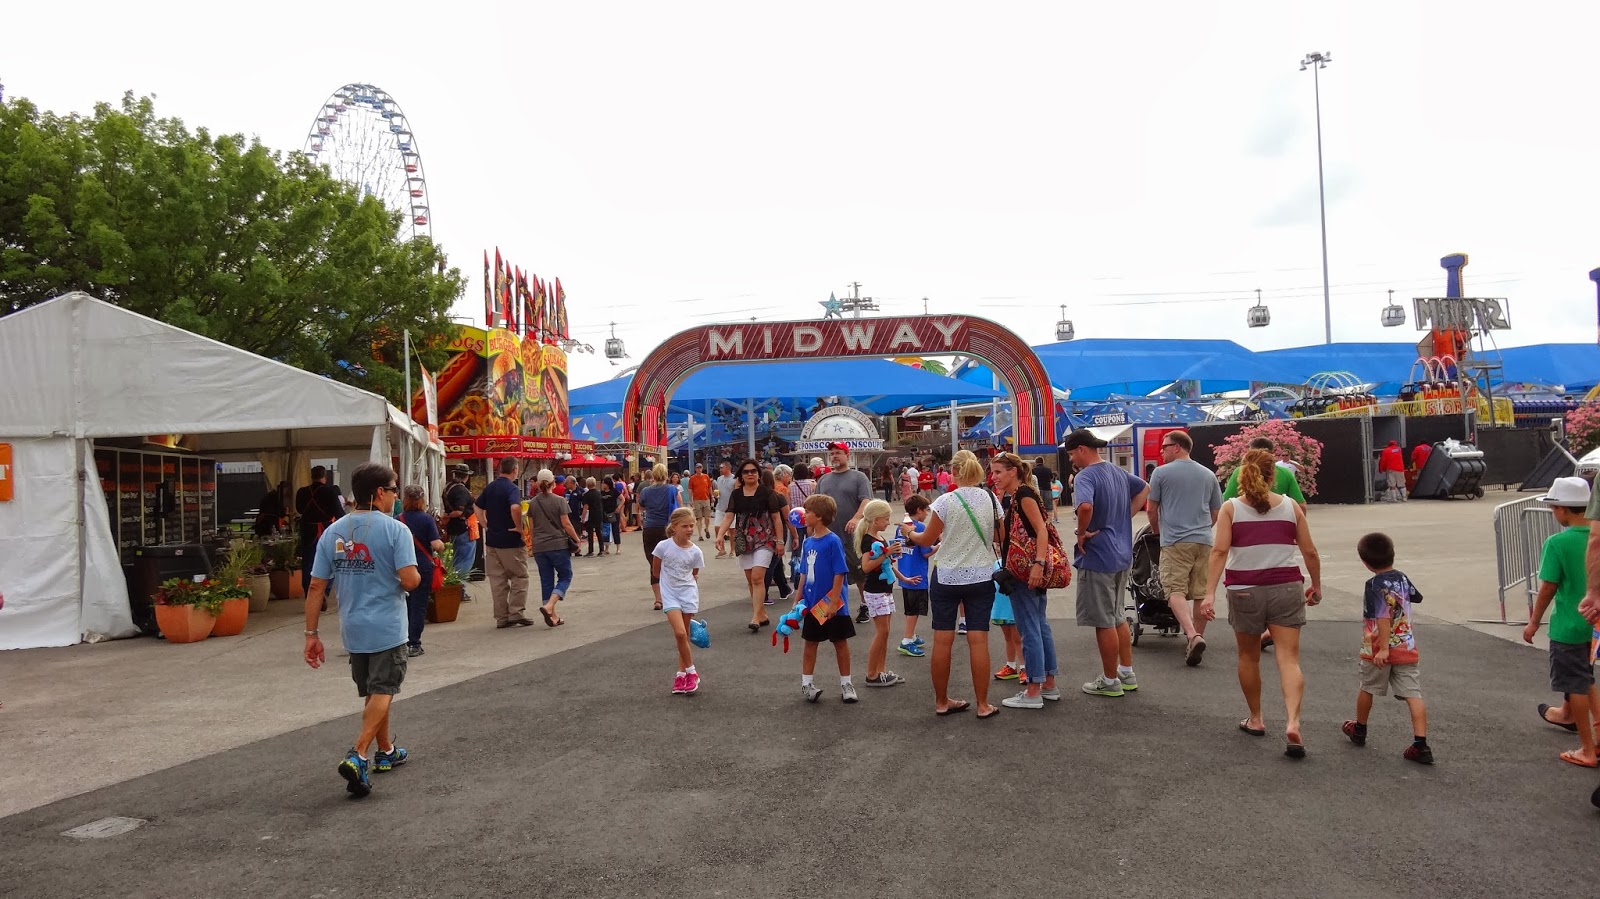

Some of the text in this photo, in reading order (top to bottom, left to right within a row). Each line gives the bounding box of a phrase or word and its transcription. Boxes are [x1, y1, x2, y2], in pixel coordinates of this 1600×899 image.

[708, 319, 964, 355] MIDWAY
[452, 336, 485, 352] OGS
[824, 407, 841, 416] FAIR
[1094, 414, 1126, 425] COUPONS
